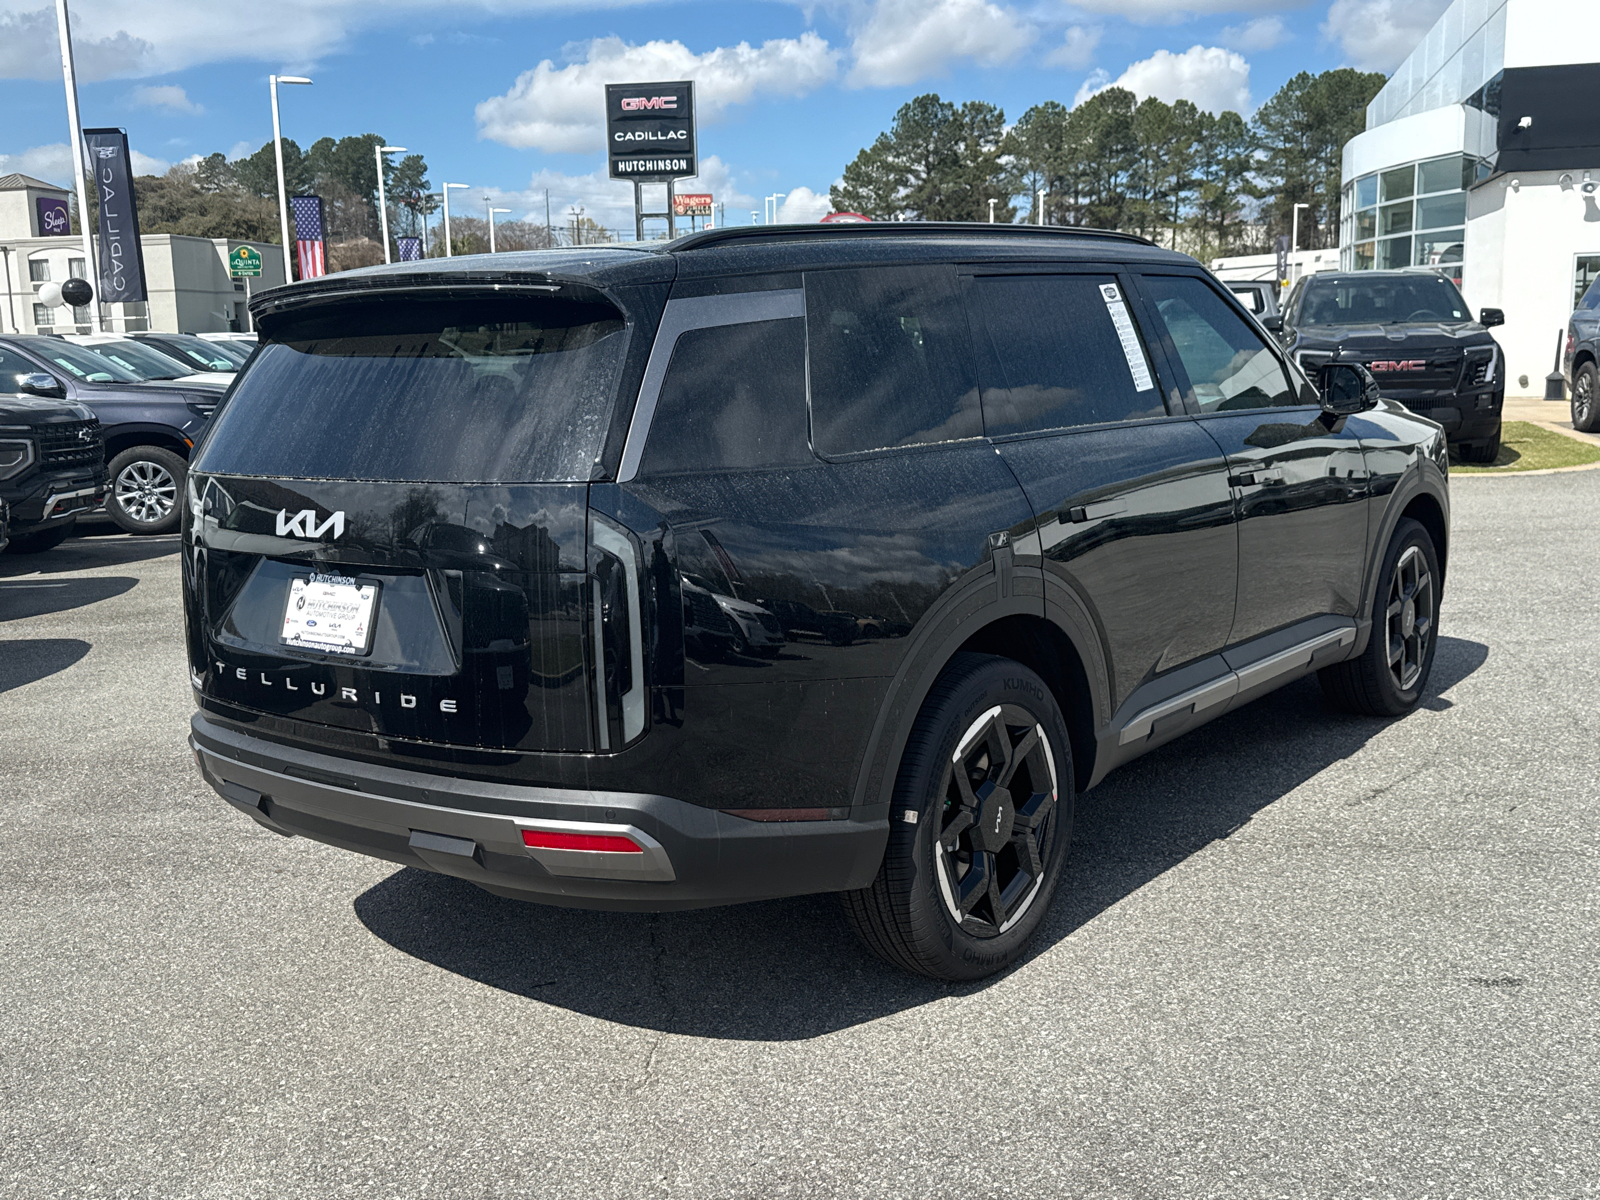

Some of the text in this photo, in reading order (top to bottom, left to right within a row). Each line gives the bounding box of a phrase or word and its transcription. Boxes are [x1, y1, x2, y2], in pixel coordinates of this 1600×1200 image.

[621, 96, 677, 111] GMC
[614, 130, 687, 141] CADILLAC
[618, 159, 687, 172] HUTCHINSON
[44, 211, 65, 230] Sleep
[1371, 360, 1426, 371] GMC
[275, 508, 345, 540] KIA
[315, 574, 356, 585] HUTCHINSON
[306, 611, 337, 619] AUTOMOTIVE
[215, 661, 458, 712] TELLURIDE
[1002, 678, 1045, 702] KUMHO
[963, 689, 988, 718] OUTSIDE
